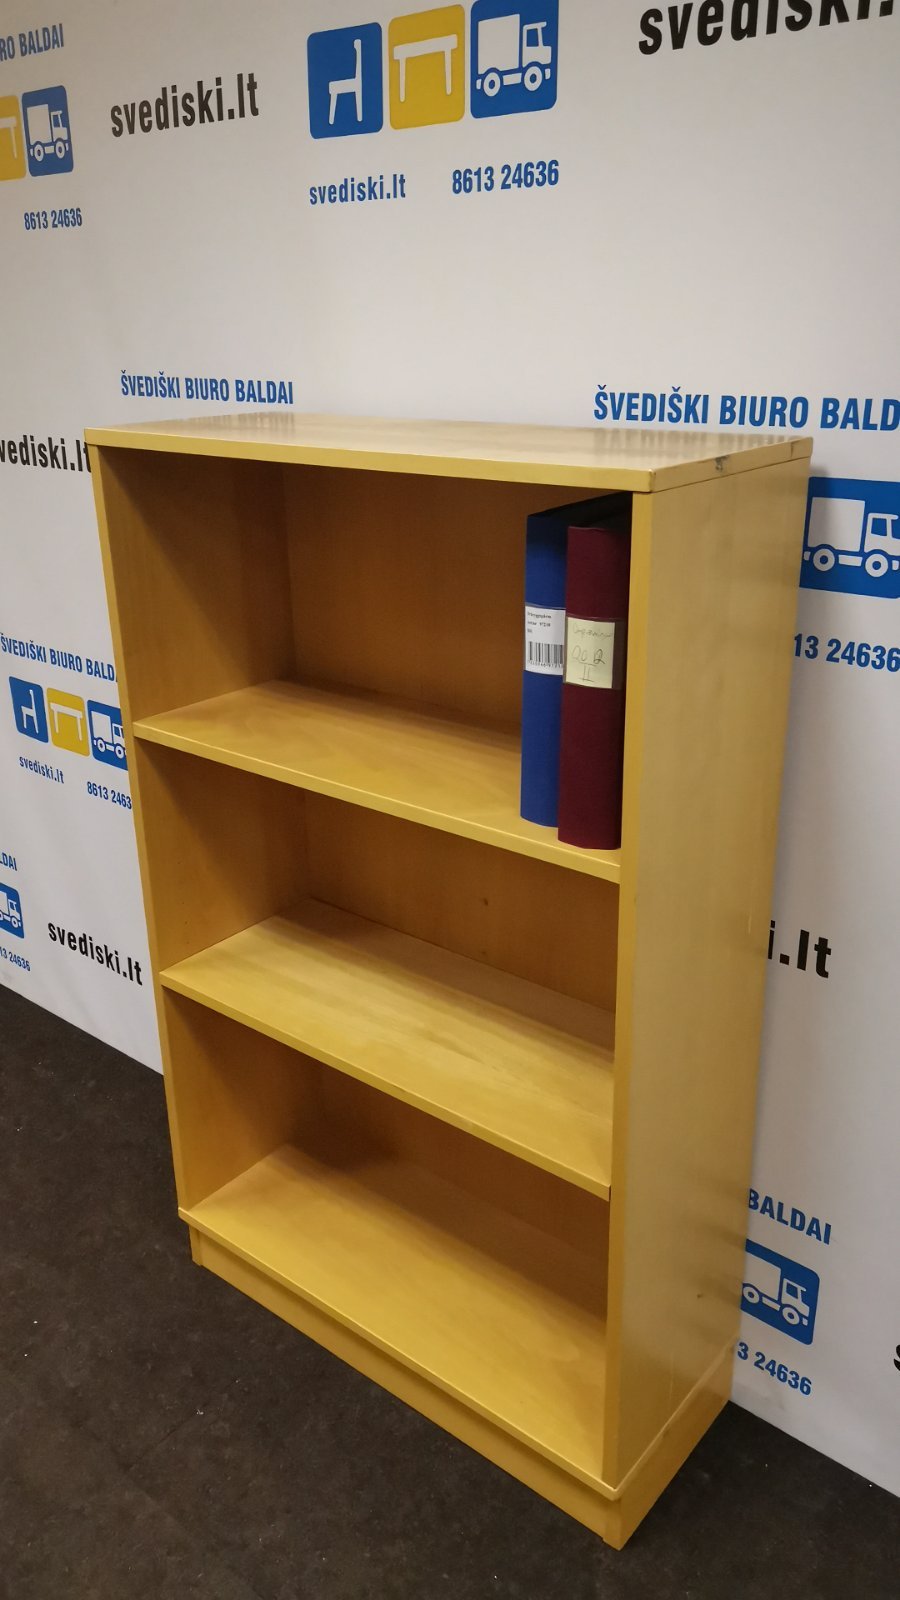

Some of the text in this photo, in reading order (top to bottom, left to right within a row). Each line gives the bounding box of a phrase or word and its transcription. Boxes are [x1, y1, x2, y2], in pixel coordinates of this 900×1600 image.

[19, 23, 64, 57] BALDAI
[111, 73, 260, 138] svediski.lt
[309, 174, 406, 205] svediski.lt
[452, 159, 559, 195] 8613 24636
[24, 208, 82, 230] 8613 24636
[121, 370, 293, 404] ŠVEDIŠKI BIURO BALDAI
[594, 385, 900, 431] ŠVEDIŠKI BIURO BALD
[0, 632, 117, 682] ŠVEDIŠKI BIURO BALD
[795, 633, 900, 672] 13 24636
[19, 756, 64, 784] svediski.lt
[87, 781, 108, 800] 8613
[48, 922, 142, 986] svediski.lt
[748, 1188, 832, 1245] BALDAI
[754, 1351, 812, 1396] 24636
